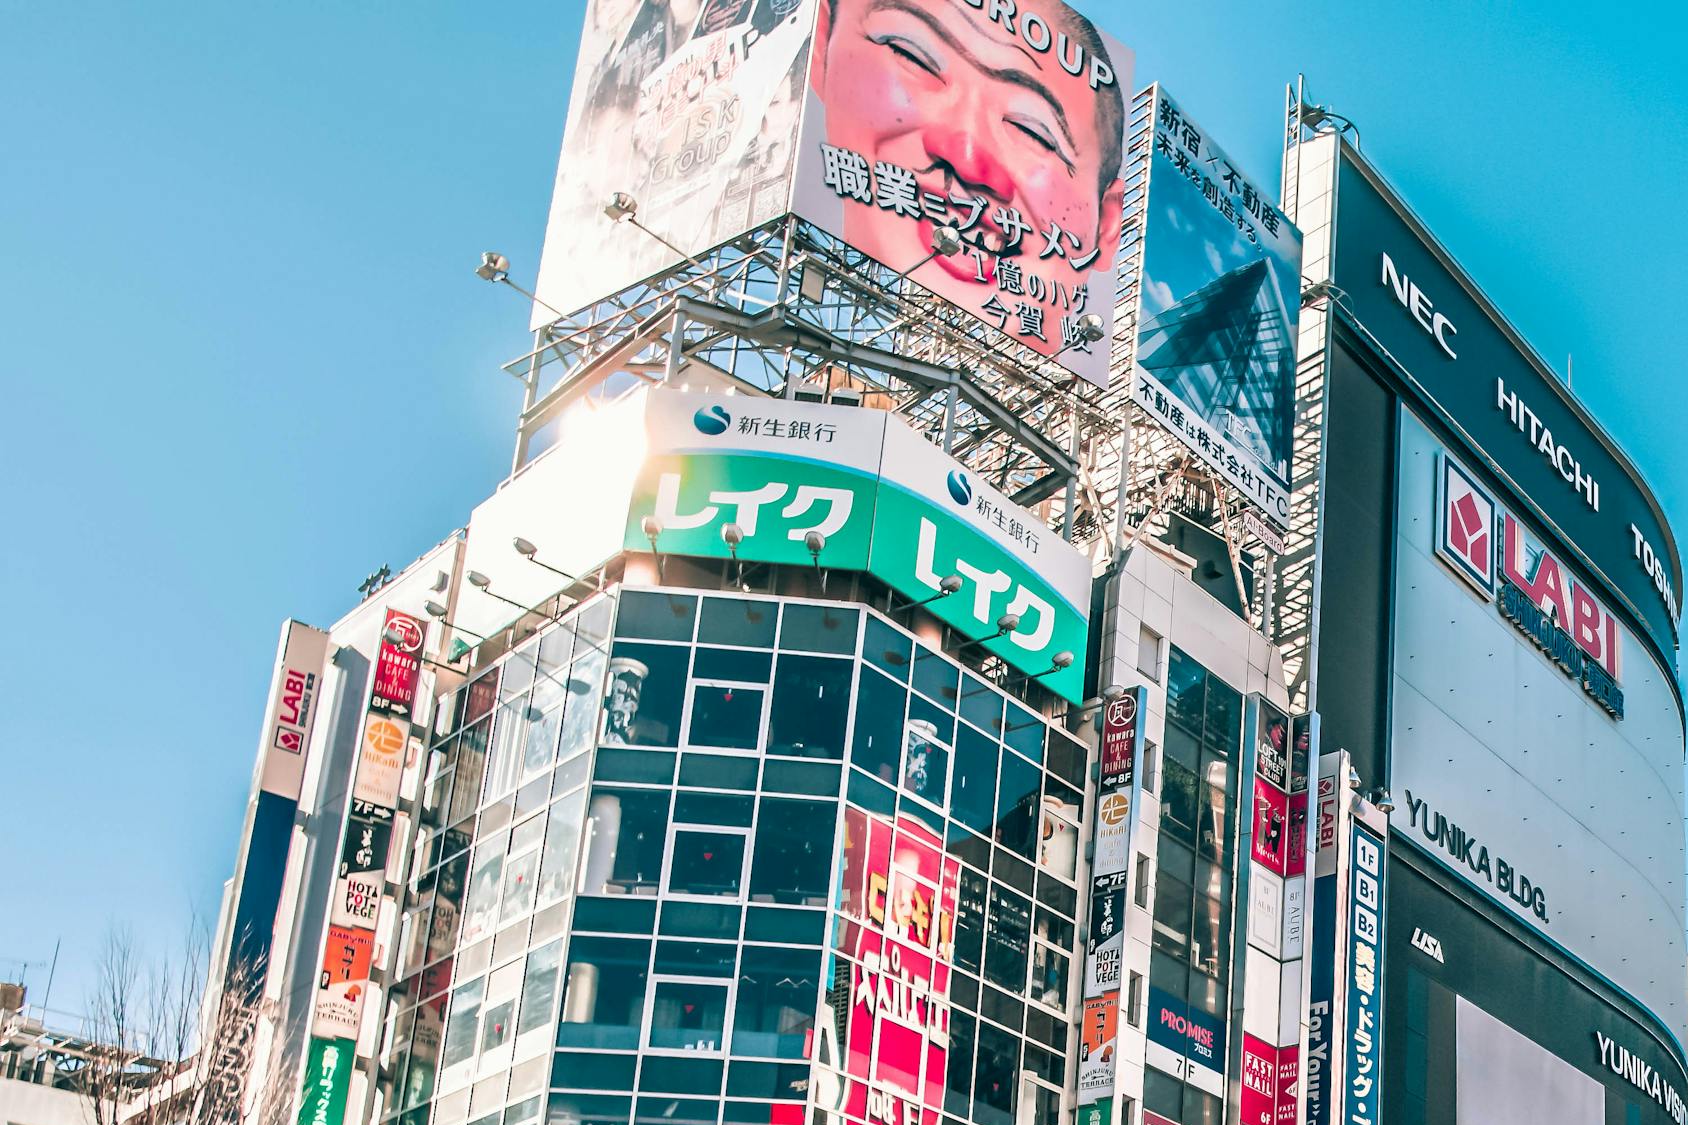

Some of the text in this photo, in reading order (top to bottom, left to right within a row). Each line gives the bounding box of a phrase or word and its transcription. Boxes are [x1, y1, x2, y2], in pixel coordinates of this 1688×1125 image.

[962, 0, 1114, 92] ROUP
[1382, 251, 1458, 360] NEC
[738, 416, 838, 443] 新生銀行
[1139, 376, 1289, 519] 不動産は株式会社TFC
[1497, 377, 1600, 513] HITACHI
[655, 473, 855, 542] レイク
[976, 494, 1041, 555] 新生銀行
[915, 517, 1056, 652] レイク
[1503, 511, 1622, 682] LABI
[382, 648, 417, 671] kawara
[385, 664, 409, 680] CAFE
[280, 670, 305, 725] LABI
[376, 681, 411, 701] DINING
[371, 696, 390, 710] 8F
[1106, 728, 1135, 745] kawara
[1110, 741, 1129, 758] CAFE
[1258, 739, 1279, 760] LOFT
[1104, 757, 1132, 775] DINING
[1260, 755, 1285, 777] STREET
[1263, 767, 1281, 784] CLUB
[1118, 771, 1132, 783] 8F
[353, 800, 374, 815] 7F
[1318, 800, 1334, 849] LABI
[1360, 843, 1375, 867] 1F
[1405, 790, 1550, 925] YUNIKA BLDG.
[348, 880, 372, 896] HOT
[1110, 872, 1126, 886] 7F
[347, 891, 372, 908] POT
[1359, 878, 1376, 902] B1
[345, 904, 374, 921] VEGE
[1358, 914, 1375, 937] B2
[1412, 926, 1445, 964] LISA
[1096, 949, 1114, 963] HOT
[1095, 970, 1119, 985] VEGE
[1096, 960, 1114, 975] POT
[1160, 1006, 1214, 1049] PROMISE
[1306, 1001, 1330, 1036] For
[1193, 1041, 1213, 1059] プロミス
[1081, 1065, 1115, 1081] SHINJUKU
[1246, 1052, 1273, 1078] FAST
[1280, 1063, 1296, 1072] FAST
[1280, 1070, 1296, 1079] NAIL
[1305, 1038, 1329, 1107] Your
[1596, 1030, 1663, 1105] YUNIKA
[1081, 1079, 1115, 1089] TERRACE
[1245, 1073, 1273, 1096] NAIL
[1260, 1112, 1271, 1125] 6F
[1278, 1104, 1295, 1113] FAST
[1278, 1111, 1295, 1120] NAIL
